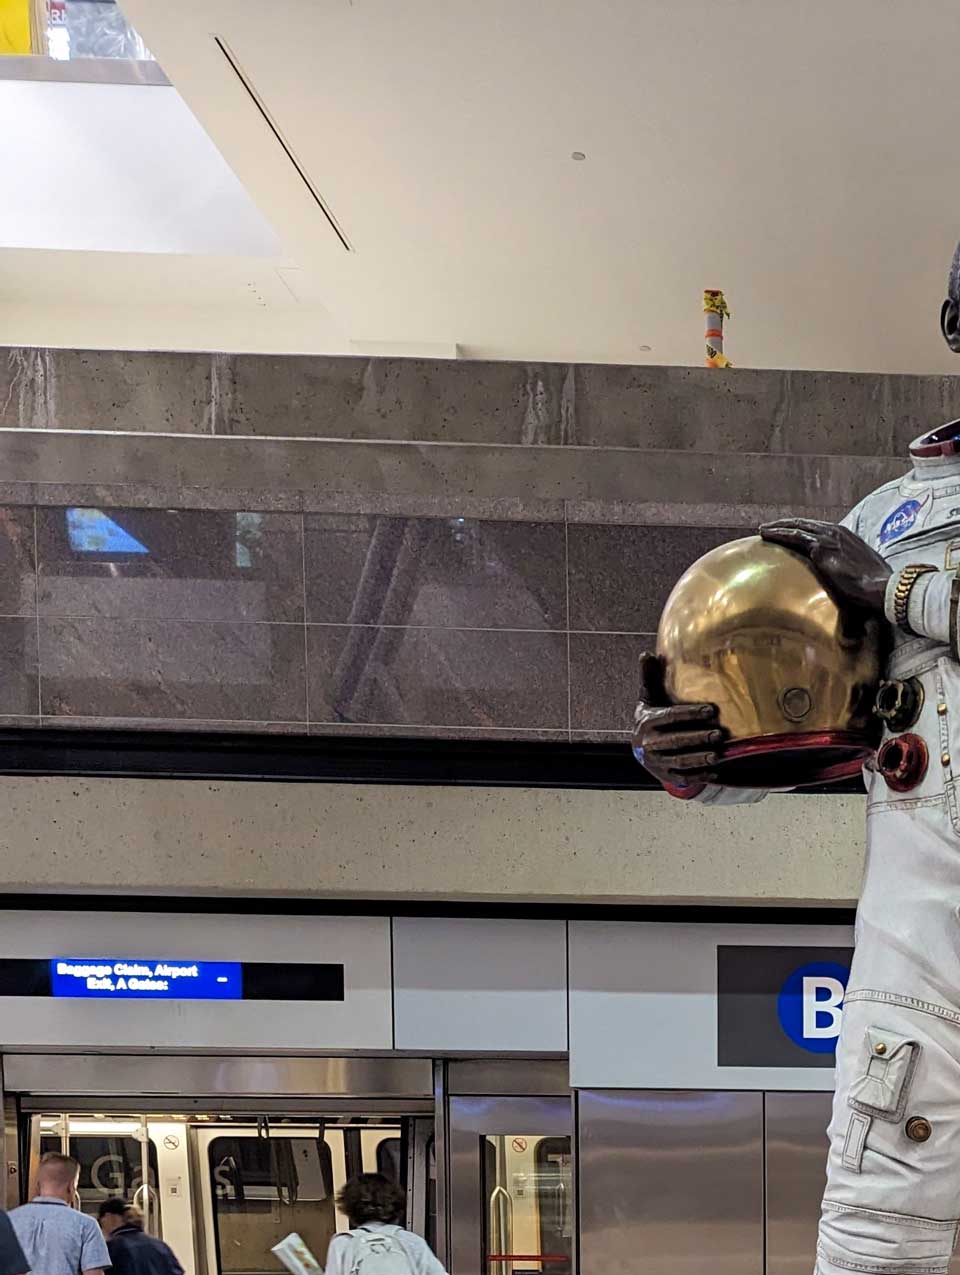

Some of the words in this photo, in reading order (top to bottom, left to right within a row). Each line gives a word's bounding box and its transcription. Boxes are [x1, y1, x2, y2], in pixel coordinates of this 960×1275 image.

[154, 964, 199, 979] Airport
[116, 978, 127, 990] A
[803, 976, 845, 1039] B
